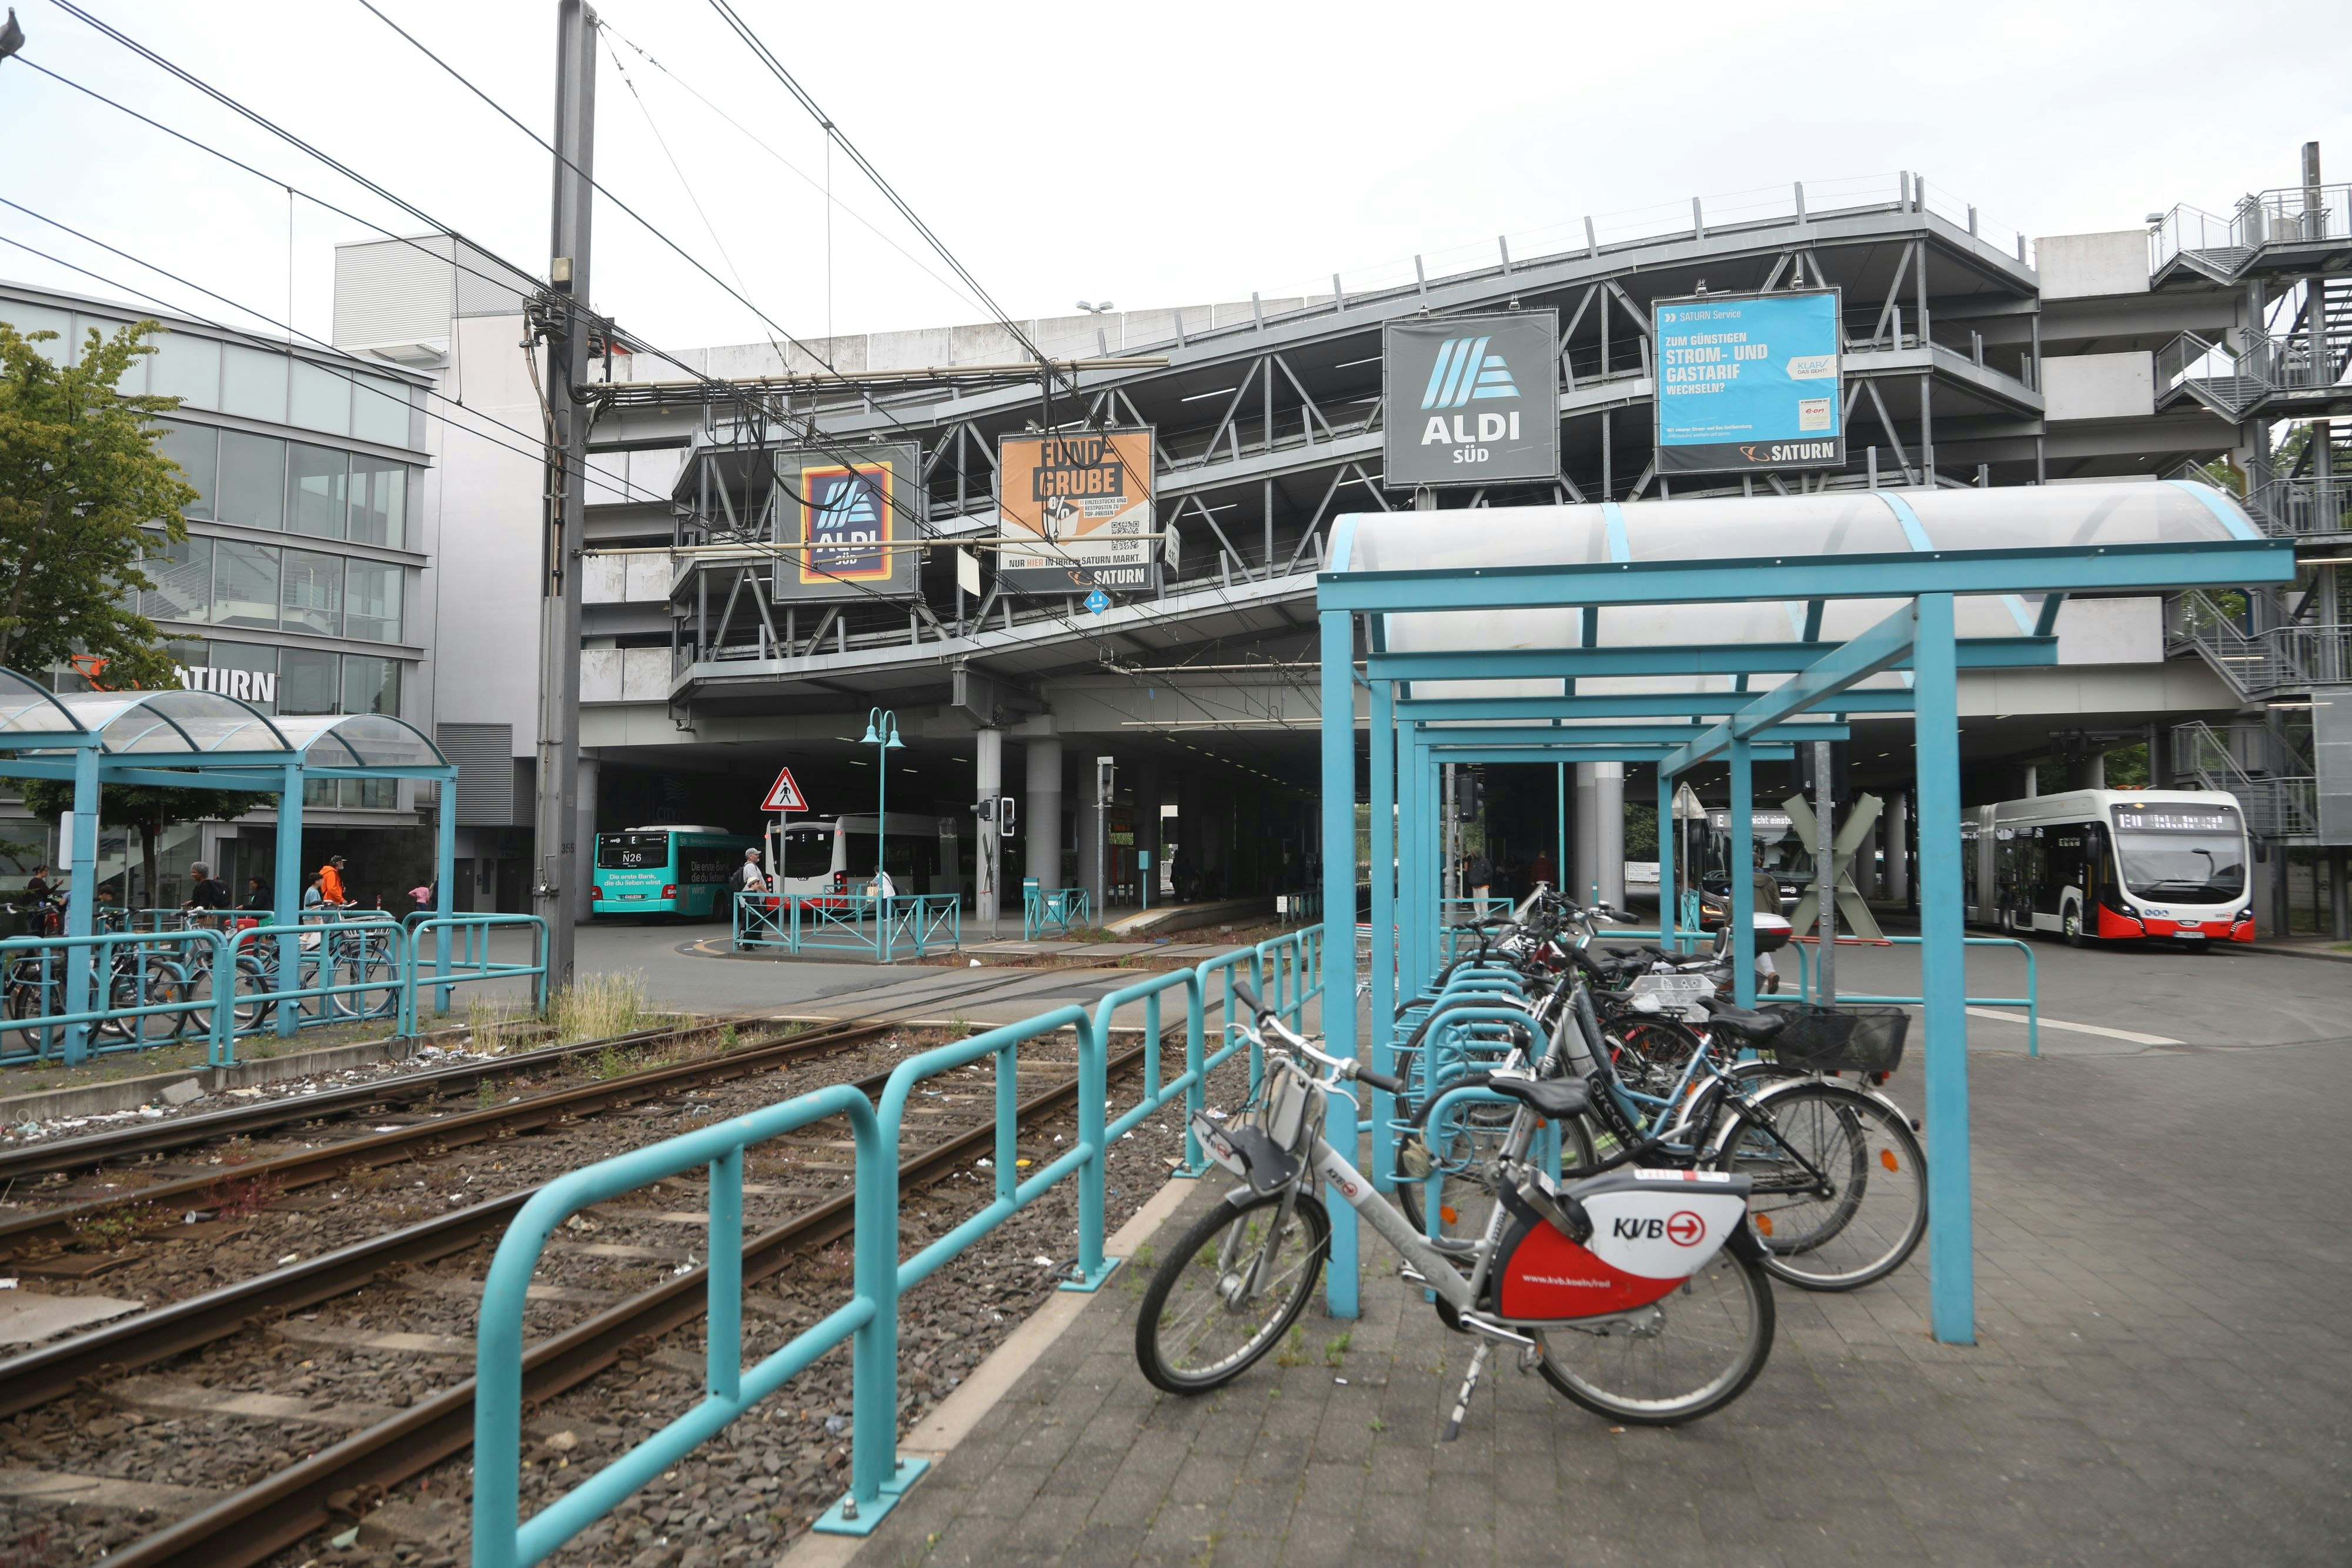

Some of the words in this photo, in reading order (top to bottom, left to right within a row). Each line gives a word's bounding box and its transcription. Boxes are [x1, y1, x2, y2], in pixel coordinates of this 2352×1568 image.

[1680, 311, 1710, 322] SATURN
[1713, 309, 1741, 319] Service
[1665, 336, 1687, 346] ZUM
[1690, 332, 1747, 346] GÜNSTIGEN
[1666, 347, 1728, 365] STROM-
[1735, 344, 1768, 360] UND
[1666, 364, 1740, 382] GASTARIF
[1666, 383, 1725, 395] WECHSELN?
[1421, 412, 1519, 445] ALDI
[1041, 440, 1114, 466] FUND-
[1453, 444, 1489, 463] SÜD
[1772, 442, 1834, 461] SATURN
[1039, 467, 1115, 496] GRUBE
[816, 530, 876, 553] ALDI
[836, 552, 857, 565] SÜD
[1009, 559, 1025, 567] NUR
[1027, 559, 1043, 567] HIER
[1056, 557, 1080, 566] IHRE
[1081, 556, 1111, 565] SATURN
[1114, 554, 1141, 563] MARKT.
[1094, 569, 1144, 584] SATURN
[175, 665, 275, 701] ATURN
[1718, 815, 1724, 827] E
[1770, 815, 1793, 824] einste
[631, 836, 636, 844] E
[561, 842, 574, 854] 355
[623, 853, 642, 862] N26
[691, 861, 700, 871] Die
[701, 862, 715, 871] erste
[691, 872, 700, 881] die
[701, 872, 708, 882] du
[709, 872, 724, 881] lieben
[691, 885, 705, 894] wirst
[1326, 1168, 1345, 1186] KVB
[1613, 1218, 1664, 1240] KVB
[1522, 1274, 1611, 1288] www.kvb.koeln/rad
